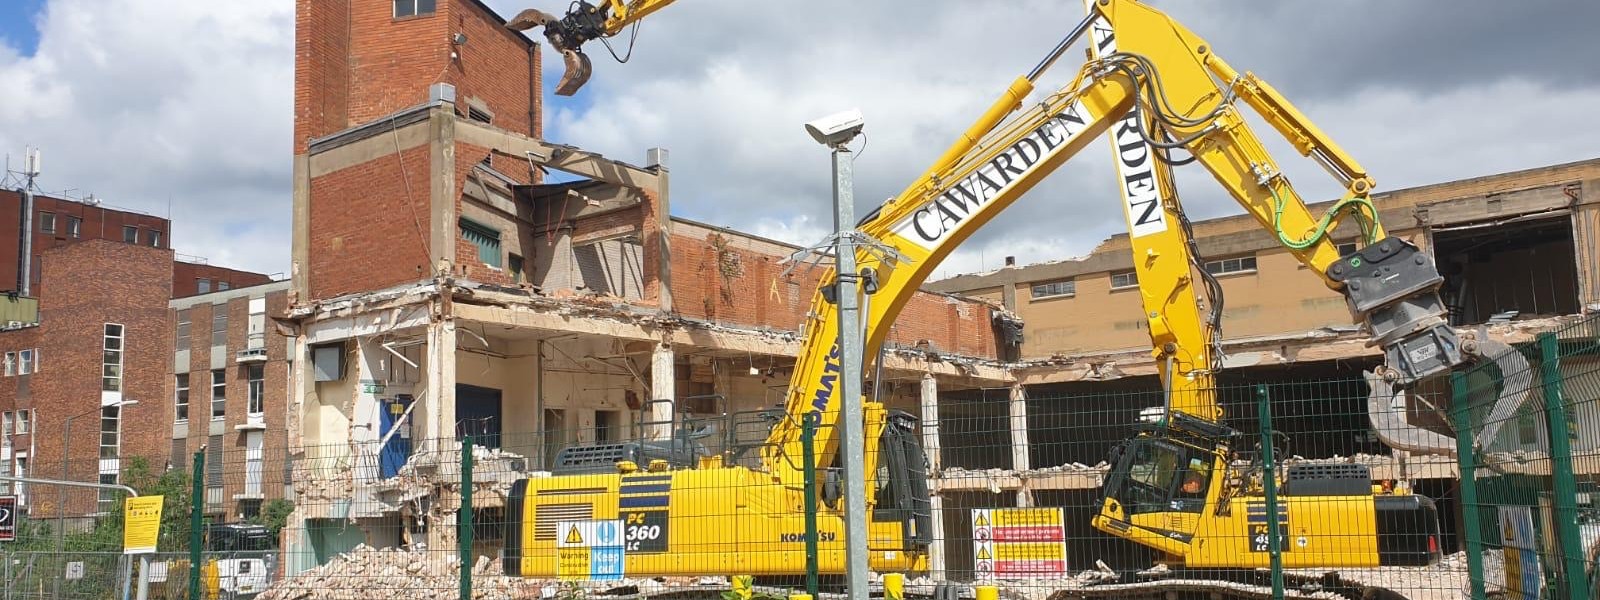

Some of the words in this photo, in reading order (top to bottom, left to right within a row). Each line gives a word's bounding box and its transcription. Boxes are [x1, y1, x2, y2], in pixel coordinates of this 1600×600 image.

[912, 104, 1086, 242] CAWARDEN
[799, 335, 841, 442] OMATS
[626, 513, 645, 524] PC
[626, 525, 660, 541] 360
[1255, 525, 1269, 534] PC
[781, 530, 835, 543] KOMSU
[627, 542, 640, 551] LC
[560, 552, 589, 560] Warning
[594, 552, 619, 564] Keep
